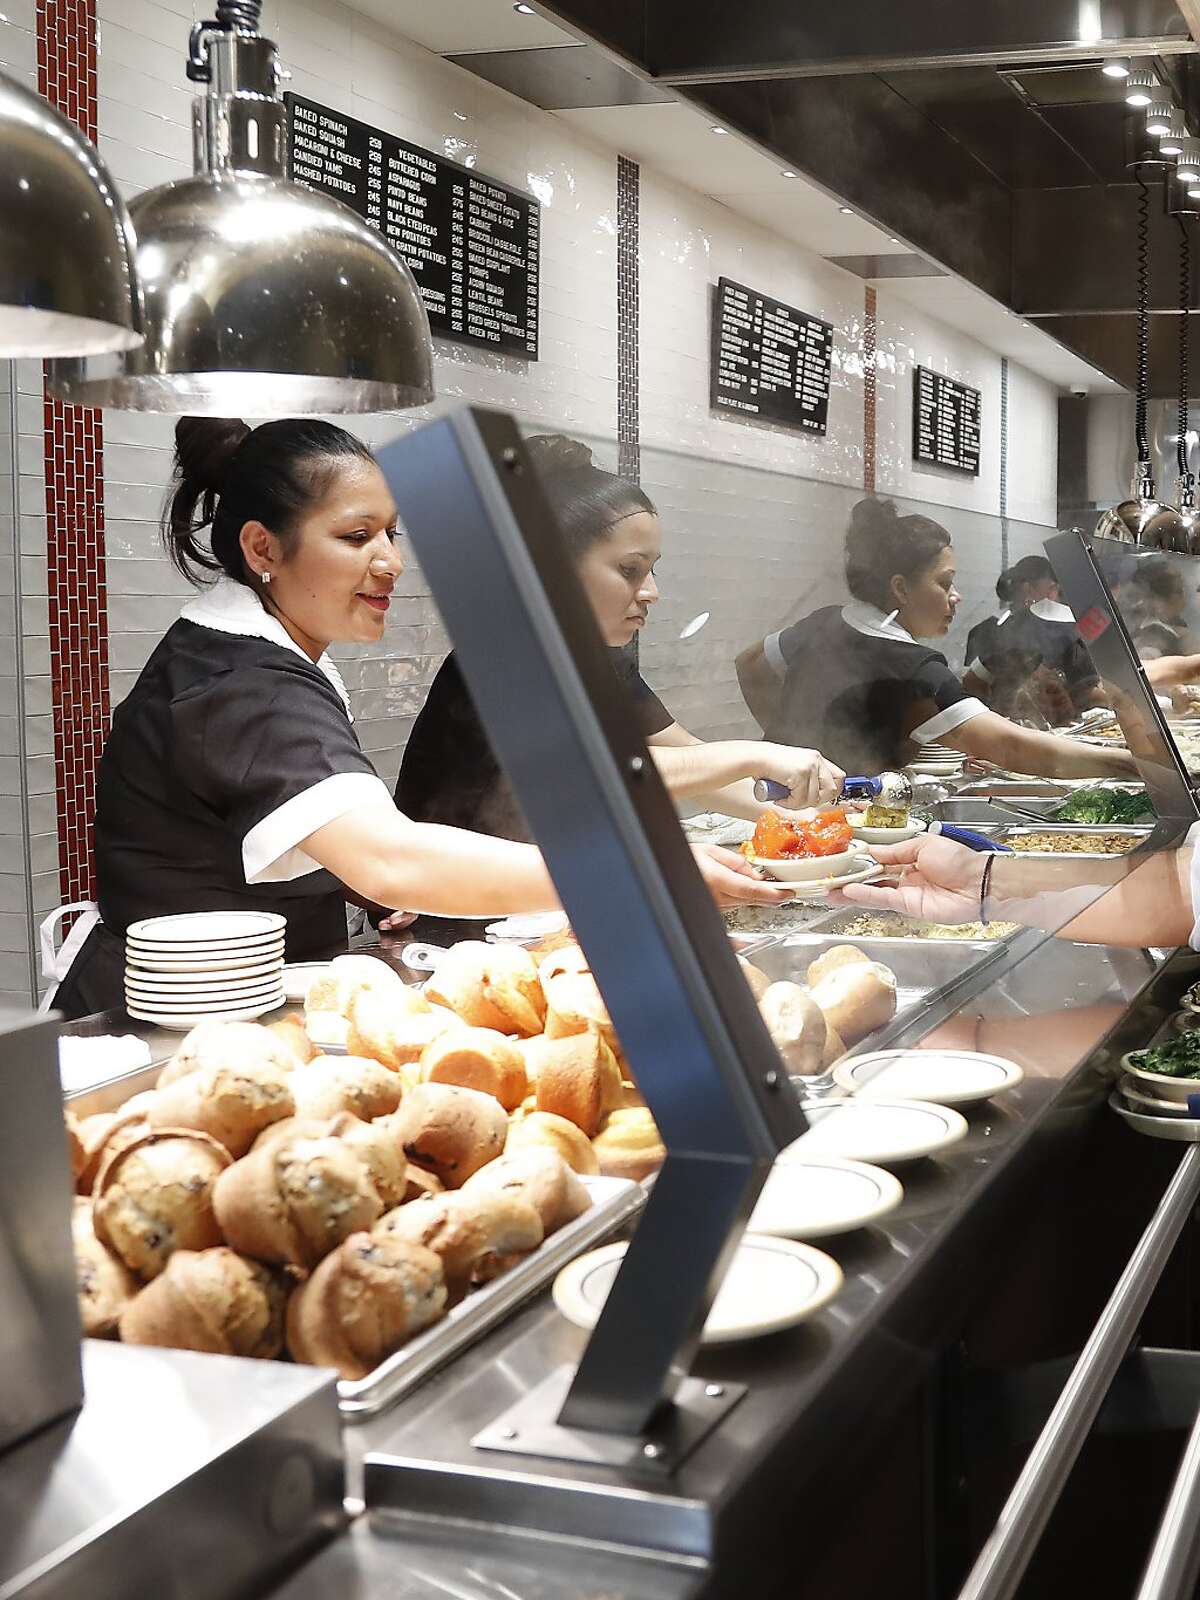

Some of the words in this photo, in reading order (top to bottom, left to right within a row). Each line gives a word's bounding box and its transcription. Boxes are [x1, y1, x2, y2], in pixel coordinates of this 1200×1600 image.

[295, 105, 317, 123] BAKED
[320, 116, 347, 136] SPINACH
[294, 120, 317, 136] BAKED
[319, 130, 345, 148] SQUASH
[294, 149, 322, 167] CANDIED
[325, 160, 342, 175] YAMS
[295, 135, 328, 156] MACARONI
[336, 151, 361, 169] CHEESE
[368, 164, 381, 176] 245
[398, 149, 437, 172] VEGETABLES
[294, 162, 321, 181] MASHED
[323, 174, 356, 194] POTATOES
[388, 158, 419, 178] BUTTERED
[421, 172, 436, 184] CORN
[388, 172, 421, 192] ASPARAGUS
[388, 185, 406, 199] PINTO
[408, 192, 427, 207] BEANS
[470, 179, 486, 193] BAKED
[388, 198, 402, 211] NAVY
[404, 204, 424, 218] BEANS
[387, 211, 406, 225] BLACK
[407, 218, 422, 231] EYED
[423, 224, 437, 236] PEAS
[387, 224, 400, 235] NEW
[402, 230, 431, 247] POTATOES
[396, 240, 417, 255] GRATIN
[418, 248, 446, 266] POTATOES
